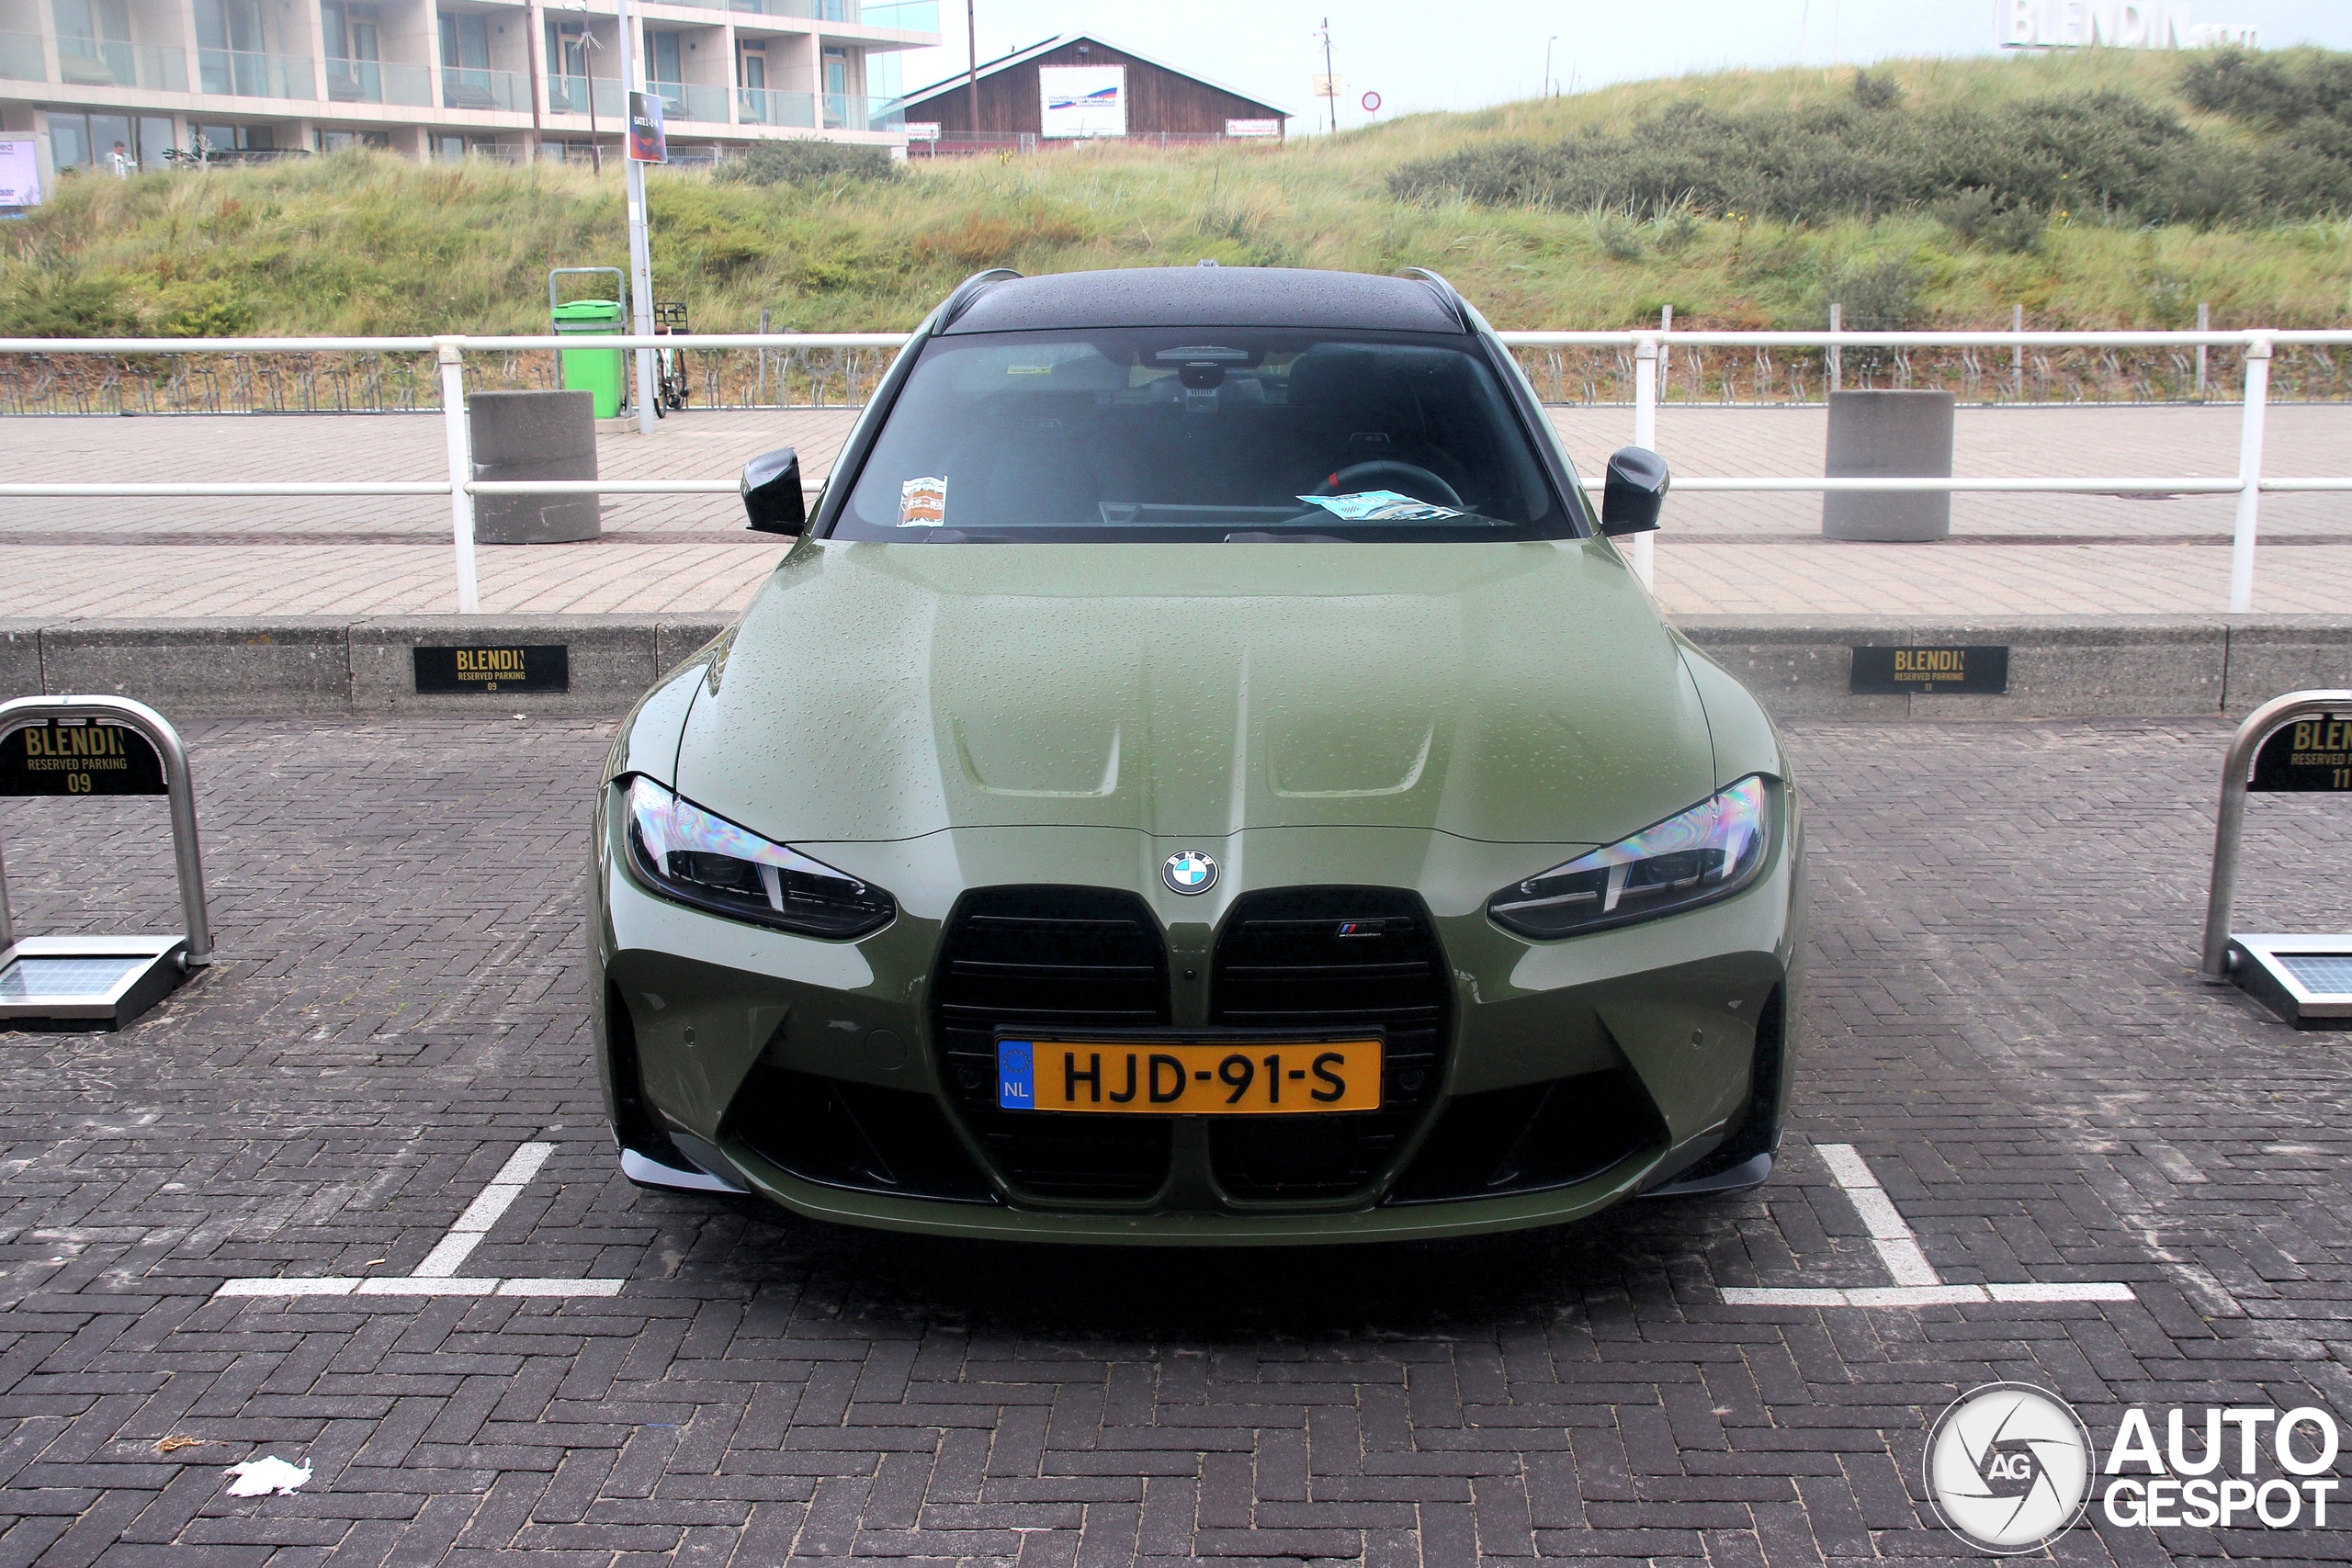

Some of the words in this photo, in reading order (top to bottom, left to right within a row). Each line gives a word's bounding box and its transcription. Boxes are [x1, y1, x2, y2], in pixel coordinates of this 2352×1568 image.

[458, 671, 493, 681] RESERVED
[494, 671, 526, 681] PARKING
[1894, 672, 1930, 682] RESERVED
[1932, 672, 1964, 682] PARKING
[487, 682, 497, 691] 09
[28, 758, 80, 771] RESERVED
[82, 758, 128, 770] PARKING
[2291, 753, 2346, 765] RESERVED
[67, 773, 91, 793] 09
[2333, 768, 2351, 788] 11
[1168, 851, 1213, 866] BMW
[1064, 1052, 1346, 1104] HJD-91-S
[1004, 1081, 1029, 1098] NL
